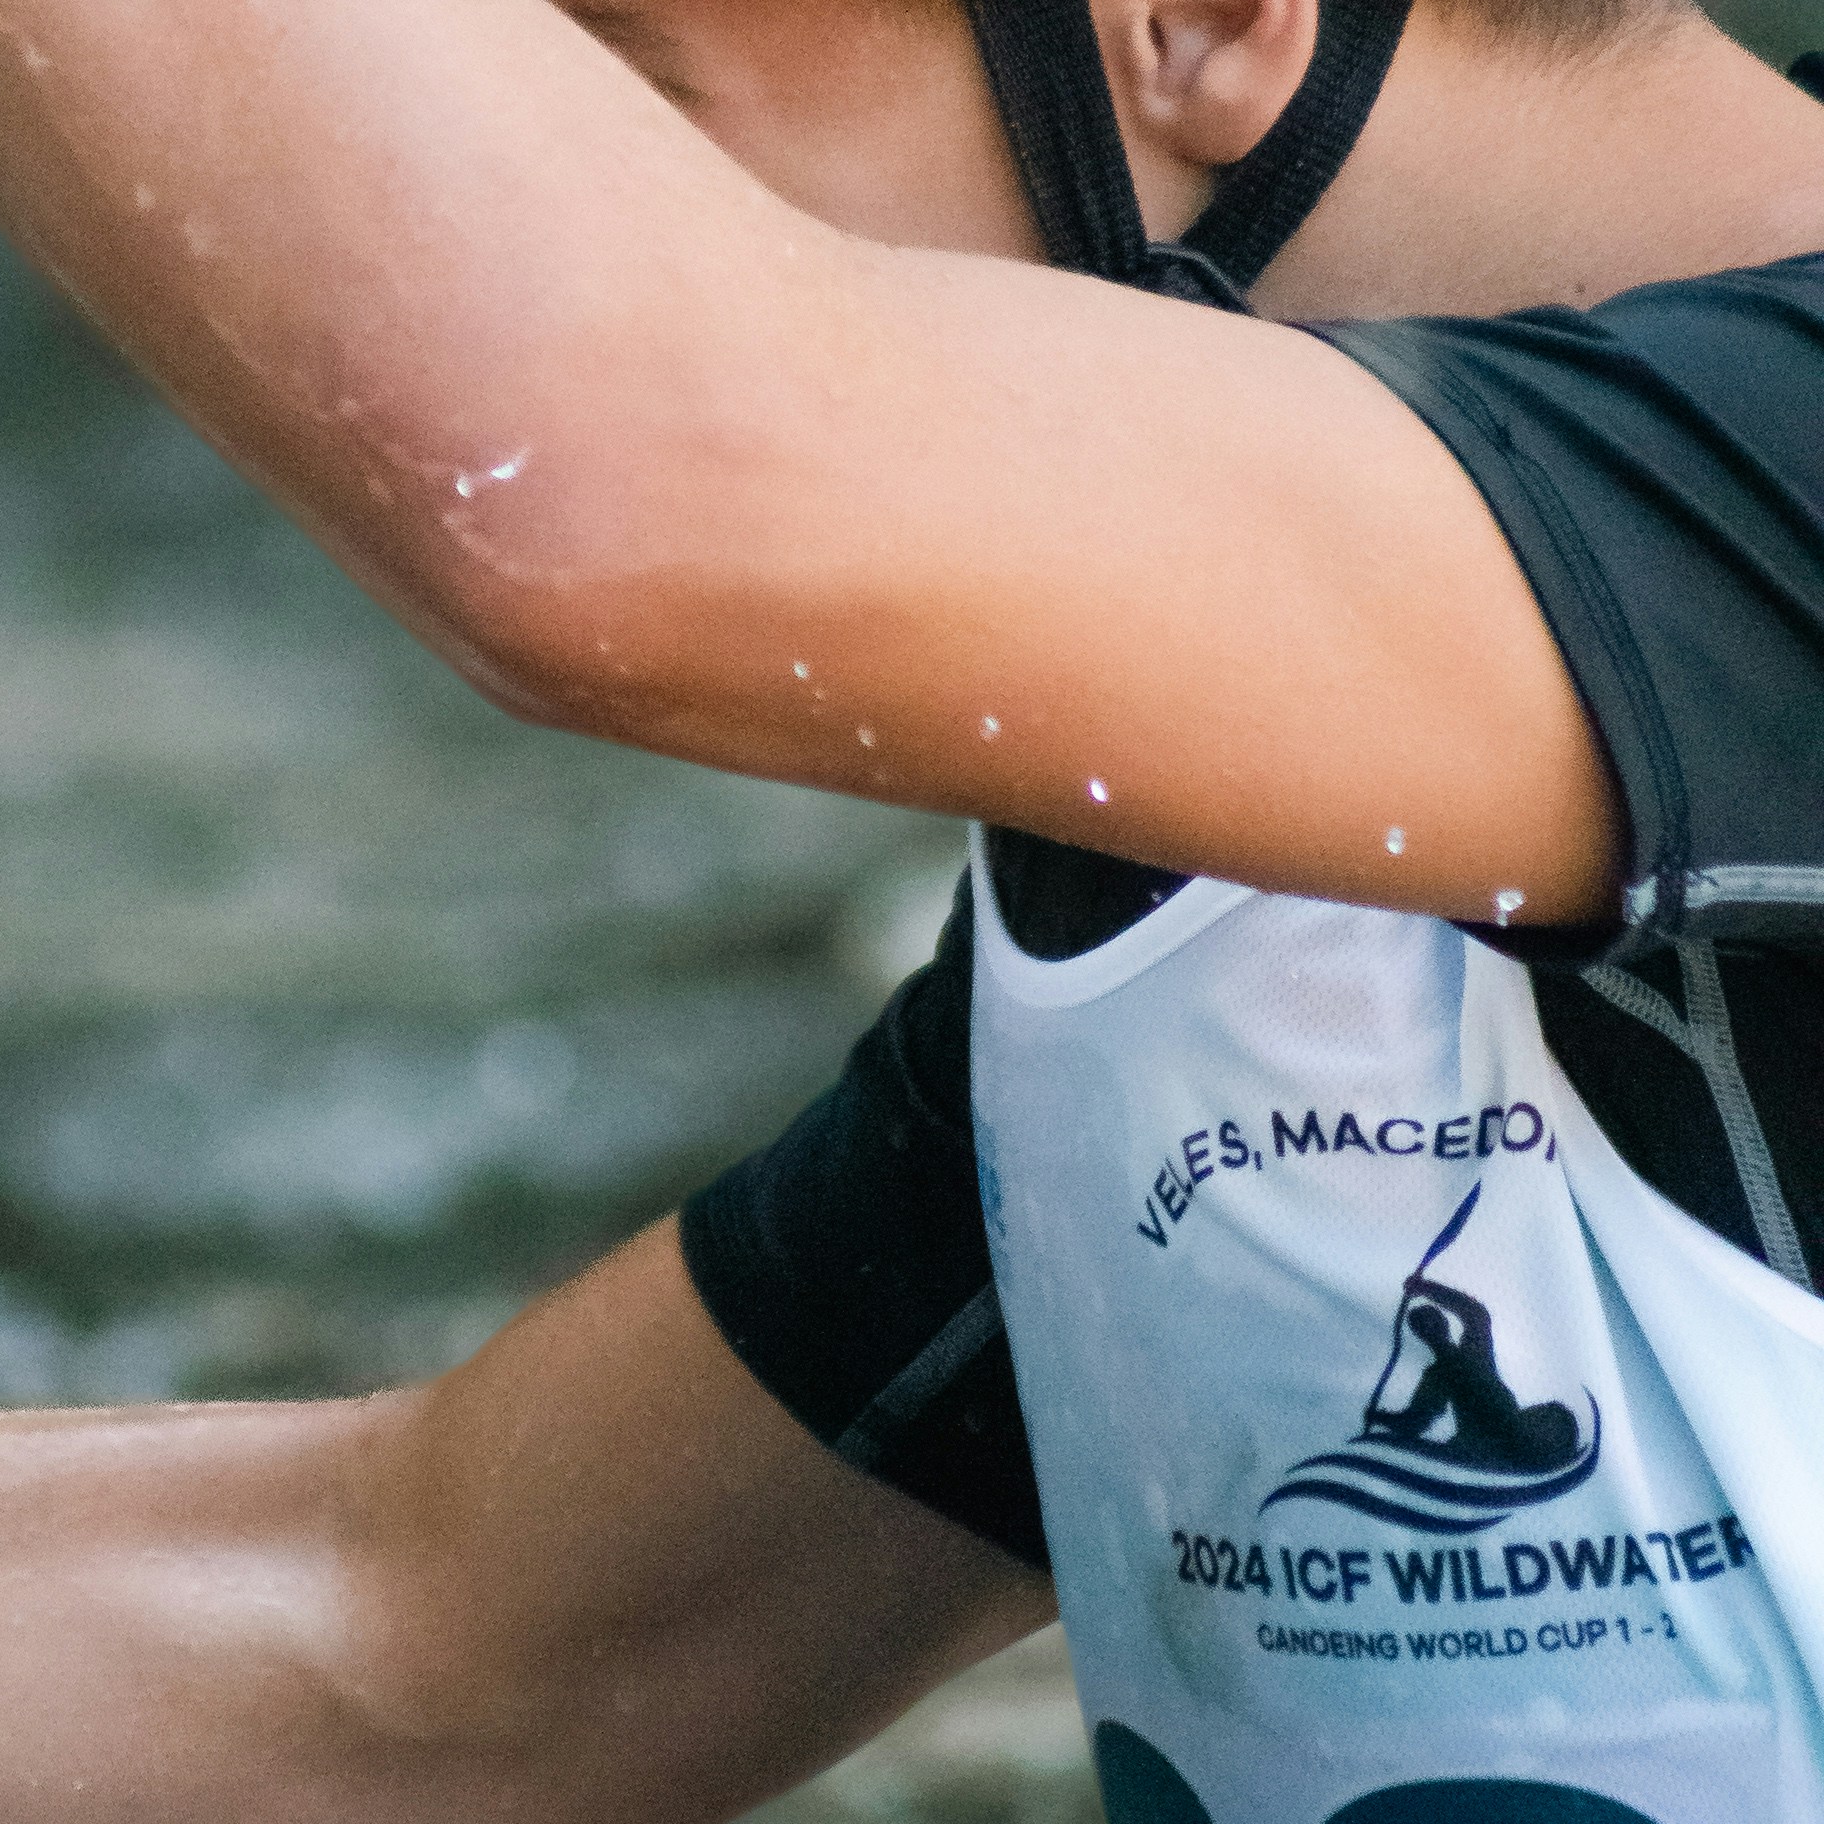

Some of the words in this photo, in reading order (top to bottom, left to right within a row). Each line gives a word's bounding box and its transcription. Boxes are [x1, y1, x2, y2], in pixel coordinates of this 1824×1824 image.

[1136, 1119, 1263, 1249] VELES,
[1271, 1101, 1556, 1163] MACEDO
[1172, 1530, 1273, 1597] 2024
[1280, 1546, 1371, 1604] ICF
[1383, 1512, 1754, 1605] WILDWATER
[1256, 1621, 1399, 1660] CANOEING
[1405, 1626, 1528, 1661] WORLD
[1536, 1618, 1608, 1653] CUP
[1615, 1615, 1631, 1645] 1
